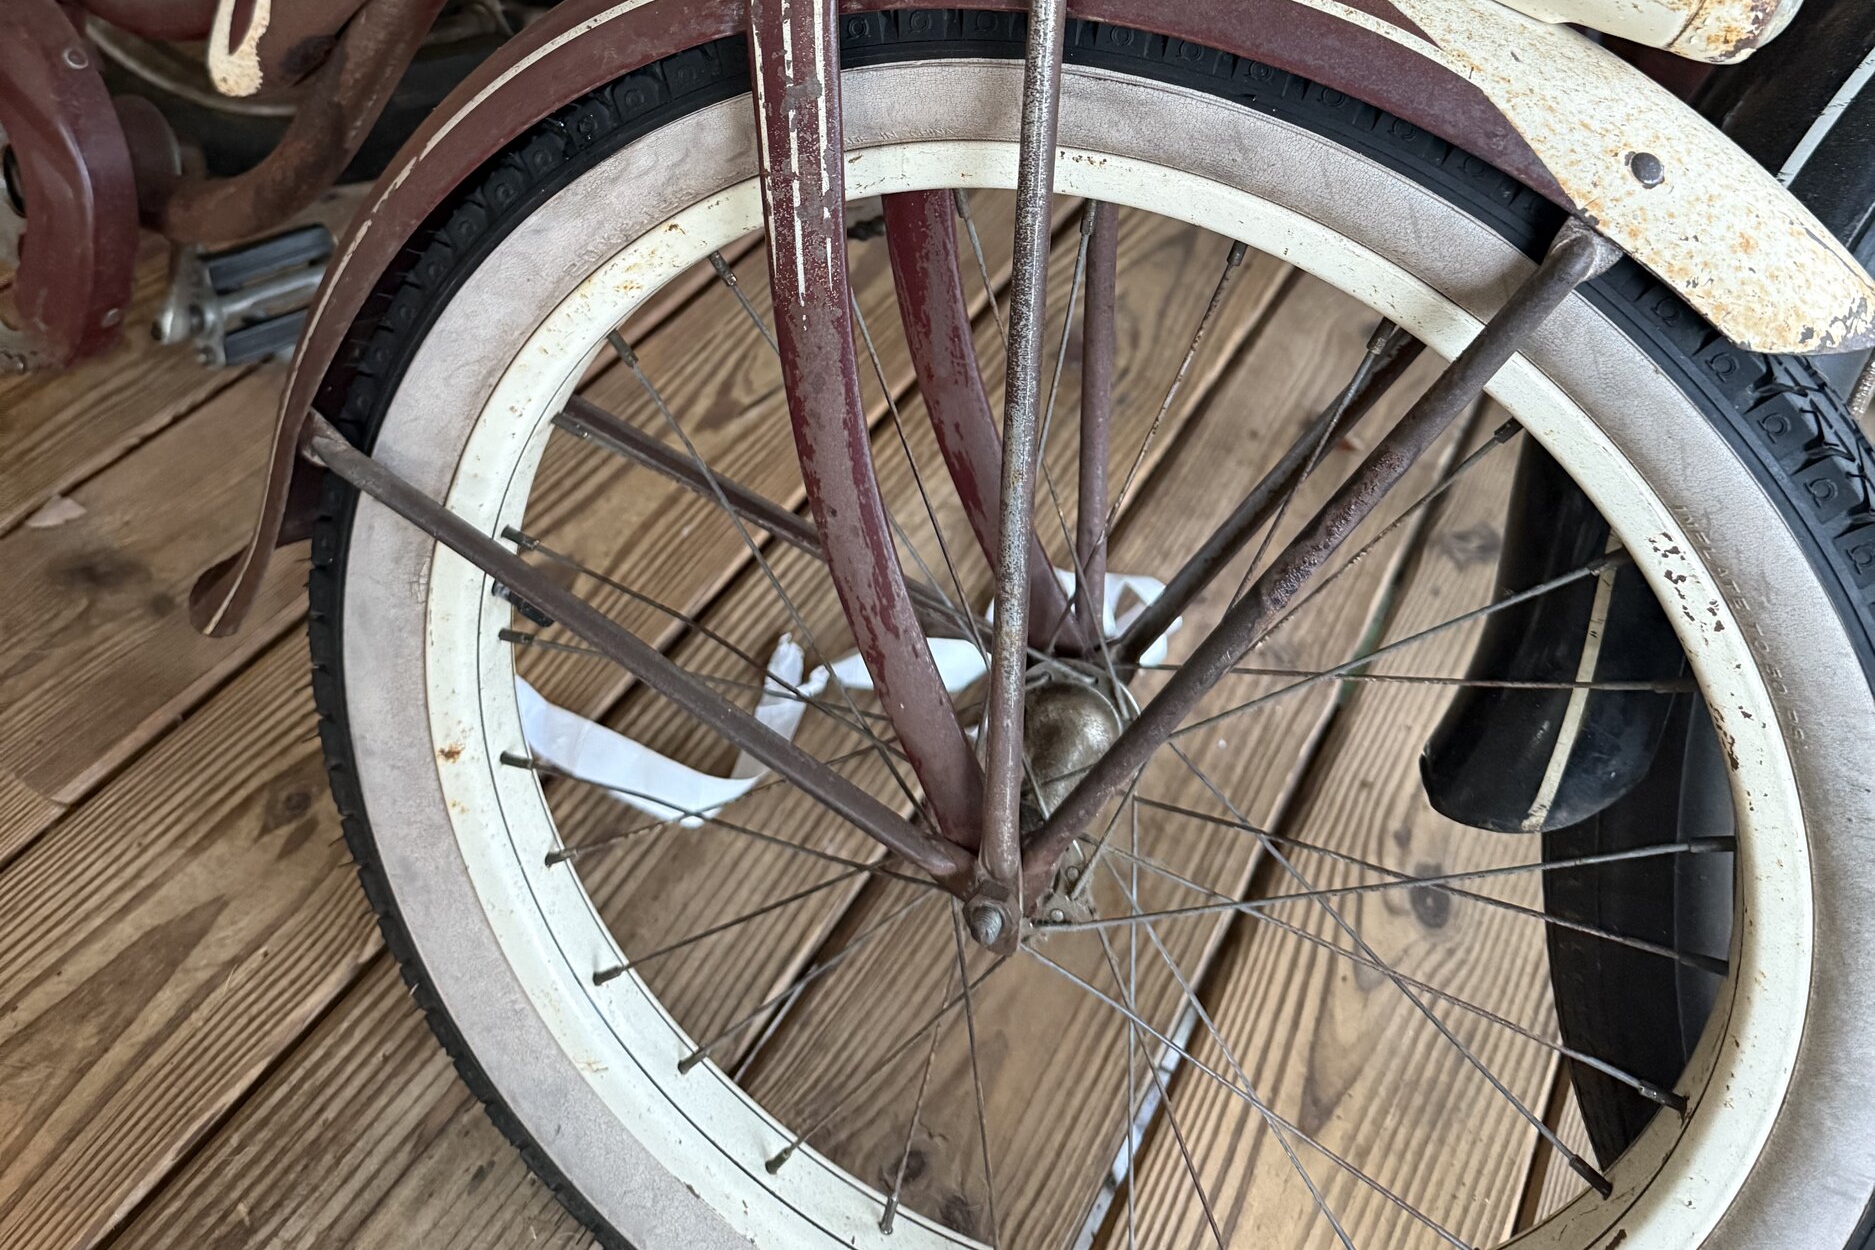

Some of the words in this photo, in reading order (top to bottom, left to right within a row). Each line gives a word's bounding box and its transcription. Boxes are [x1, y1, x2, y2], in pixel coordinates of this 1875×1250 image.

[843, 133, 870, 145] ADE
[879, 130, 899, 140] IN
[1674, 505, 1751, 612] INFLATE
